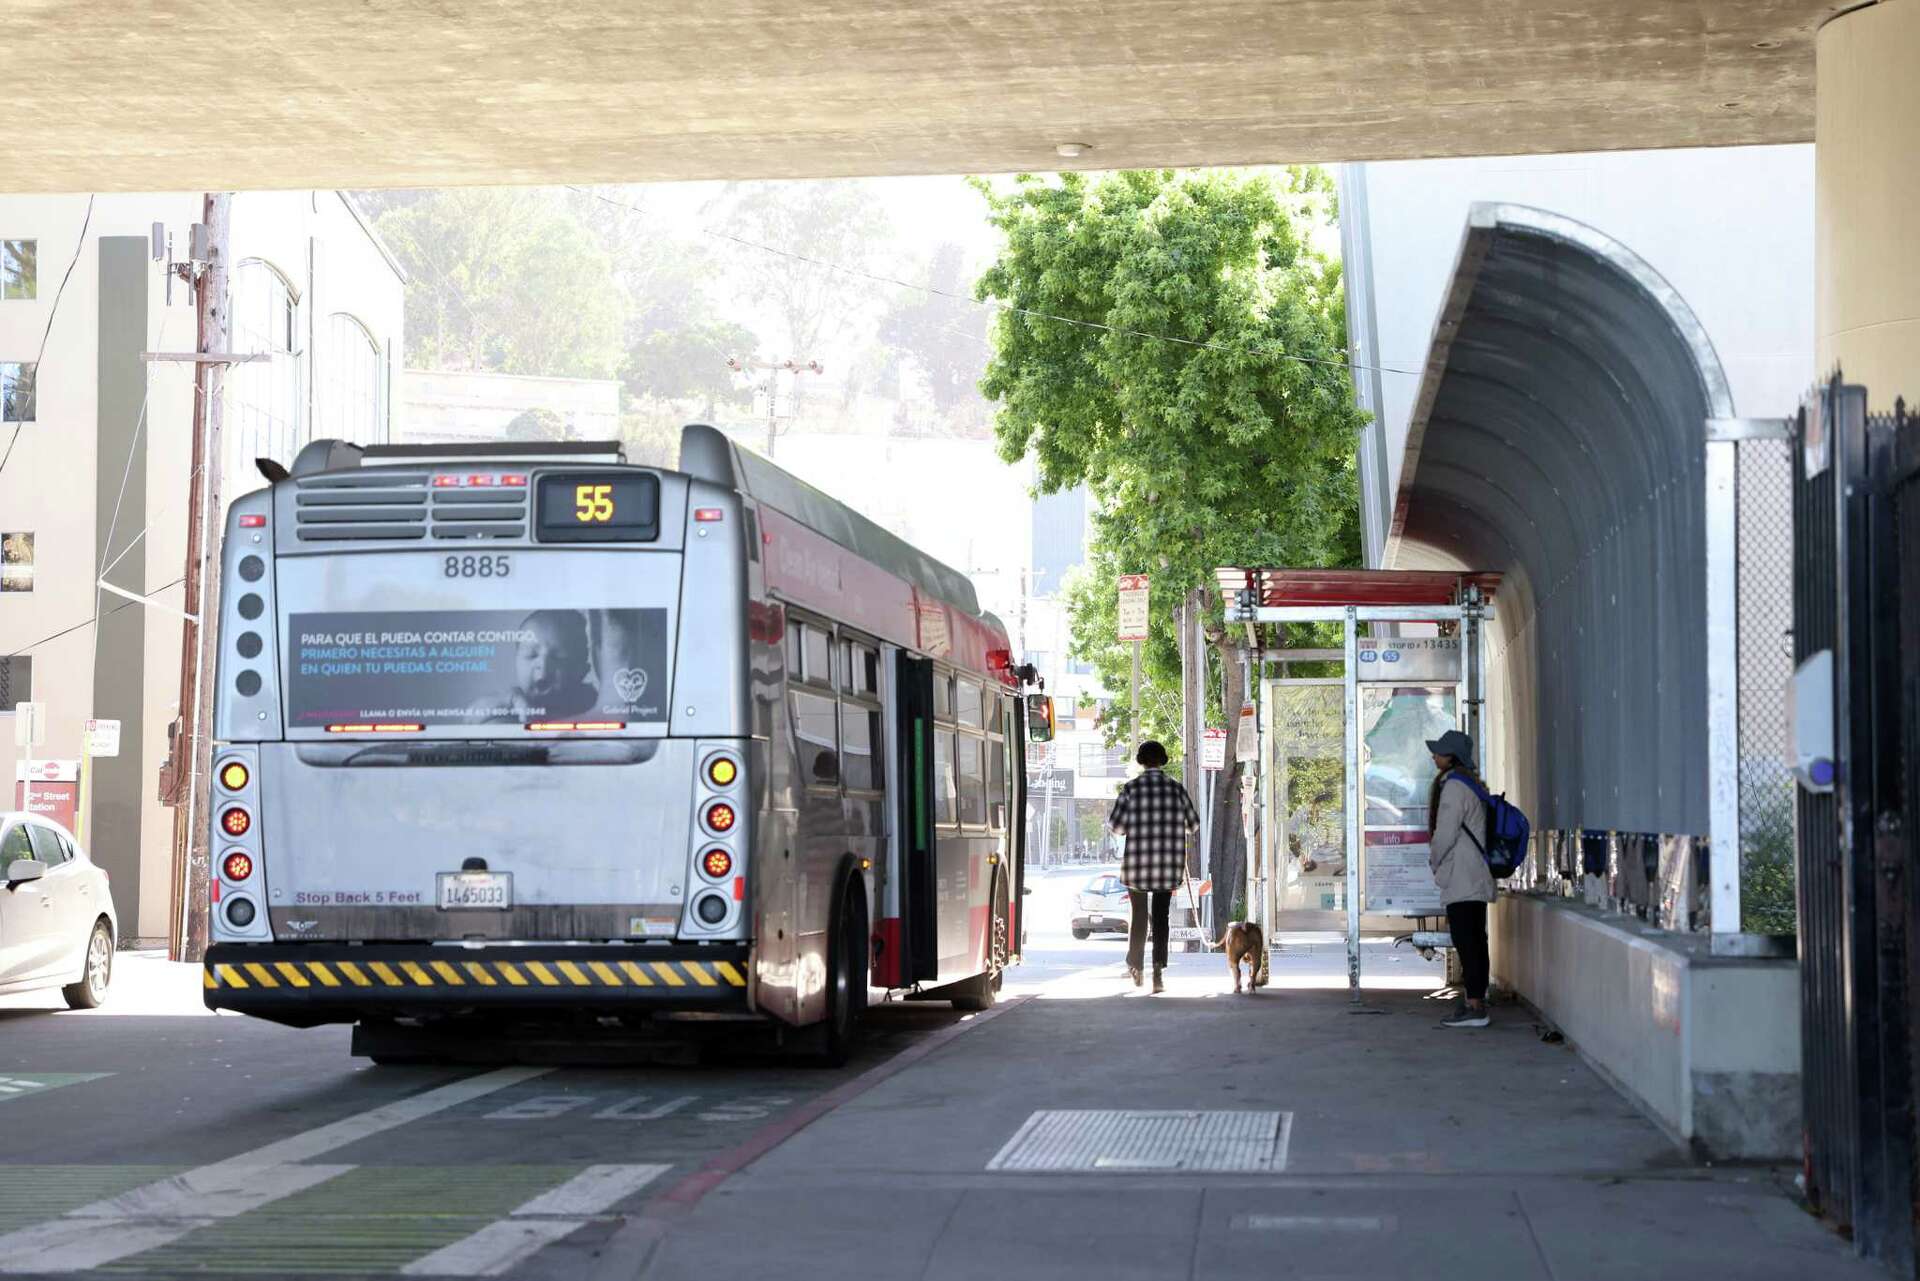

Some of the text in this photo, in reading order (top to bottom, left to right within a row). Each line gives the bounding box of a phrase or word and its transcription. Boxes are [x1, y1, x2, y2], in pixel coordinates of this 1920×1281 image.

[576, 485, 614, 521] 55
[444, 556, 510, 578] 8885
[301, 633, 333, 645] PARA
[335, 632, 362, 647] QUE
[365, 632, 378, 645] EL
[381, 632, 421, 644] PUEDA
[424, 631, 475, 644] CONTAR
[1424, 640, 1458, 649] 13435
[301, 645, 496, 660] PRIMERO NECESITAS A ALGUIEN
[301, 663, 319, 674] EN
[321, 662, 361, 676] QUIEN
[366, 662, 380, 674] TU
[384, 661, 432, 673] PUEDAS
[360, 709, 387, 718] LLAMA
[43, 791, 70, 801] Street
[29, 802, 56, 812] tation
[296, 891, 421, 905] Stop Back 5 Feet
[447, 887, 503, 903] 1465033
[481, 1096, 793, 1121] BUS
